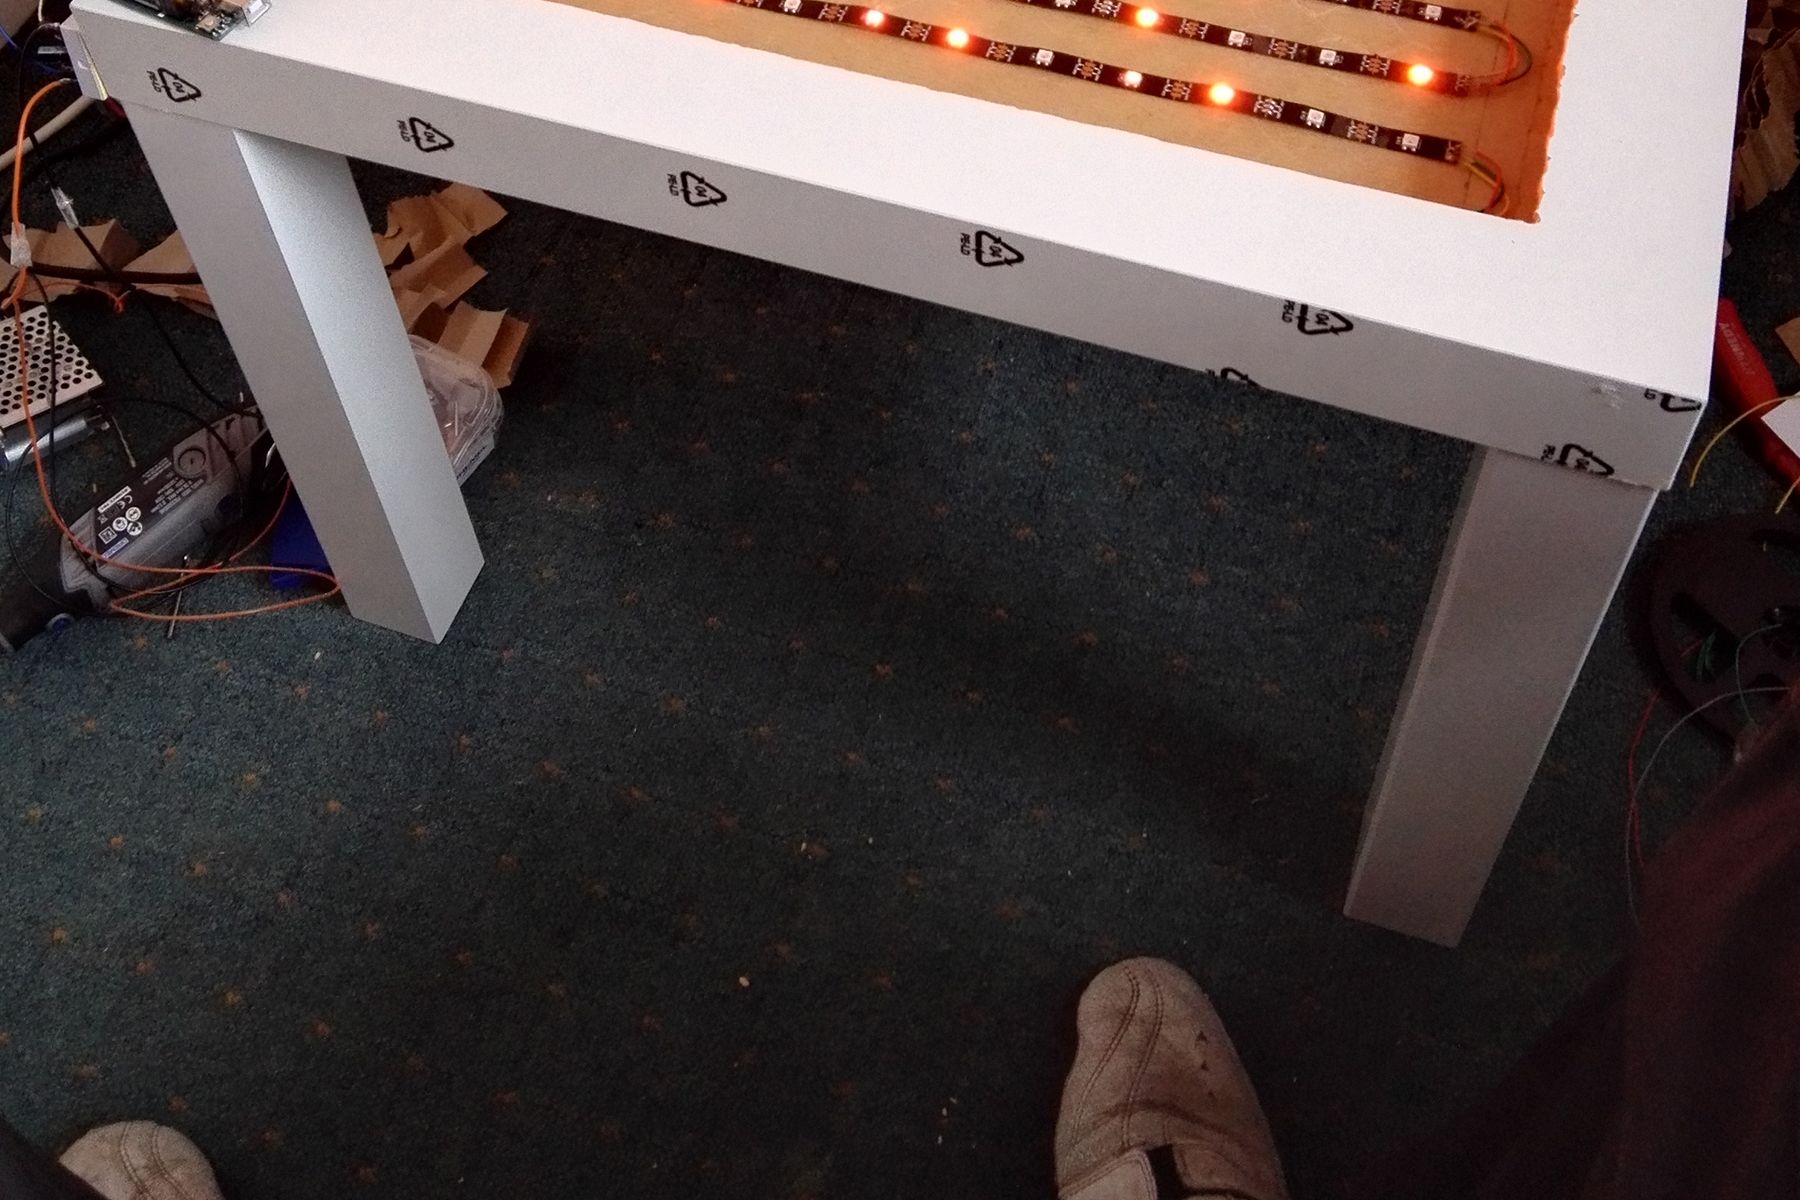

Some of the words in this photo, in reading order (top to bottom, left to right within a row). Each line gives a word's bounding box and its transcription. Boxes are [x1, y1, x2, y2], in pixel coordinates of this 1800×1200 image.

[172, 81, 185, 93] 04
[396, 119, 411, 142] PE-LD
[423, 130, 436, 143] 04
[666, 173, 679, 196] PE-LD
[694, 185, 708, 198] 04
[960, 232, 971, 256] PE-LD
[989, 245, 1002, 258] 04
[1281, 299, 1296, 323] PE-LD
[1314, 312, 1329, 326] 04
[1541, 444, 1556, 461] PE-L
